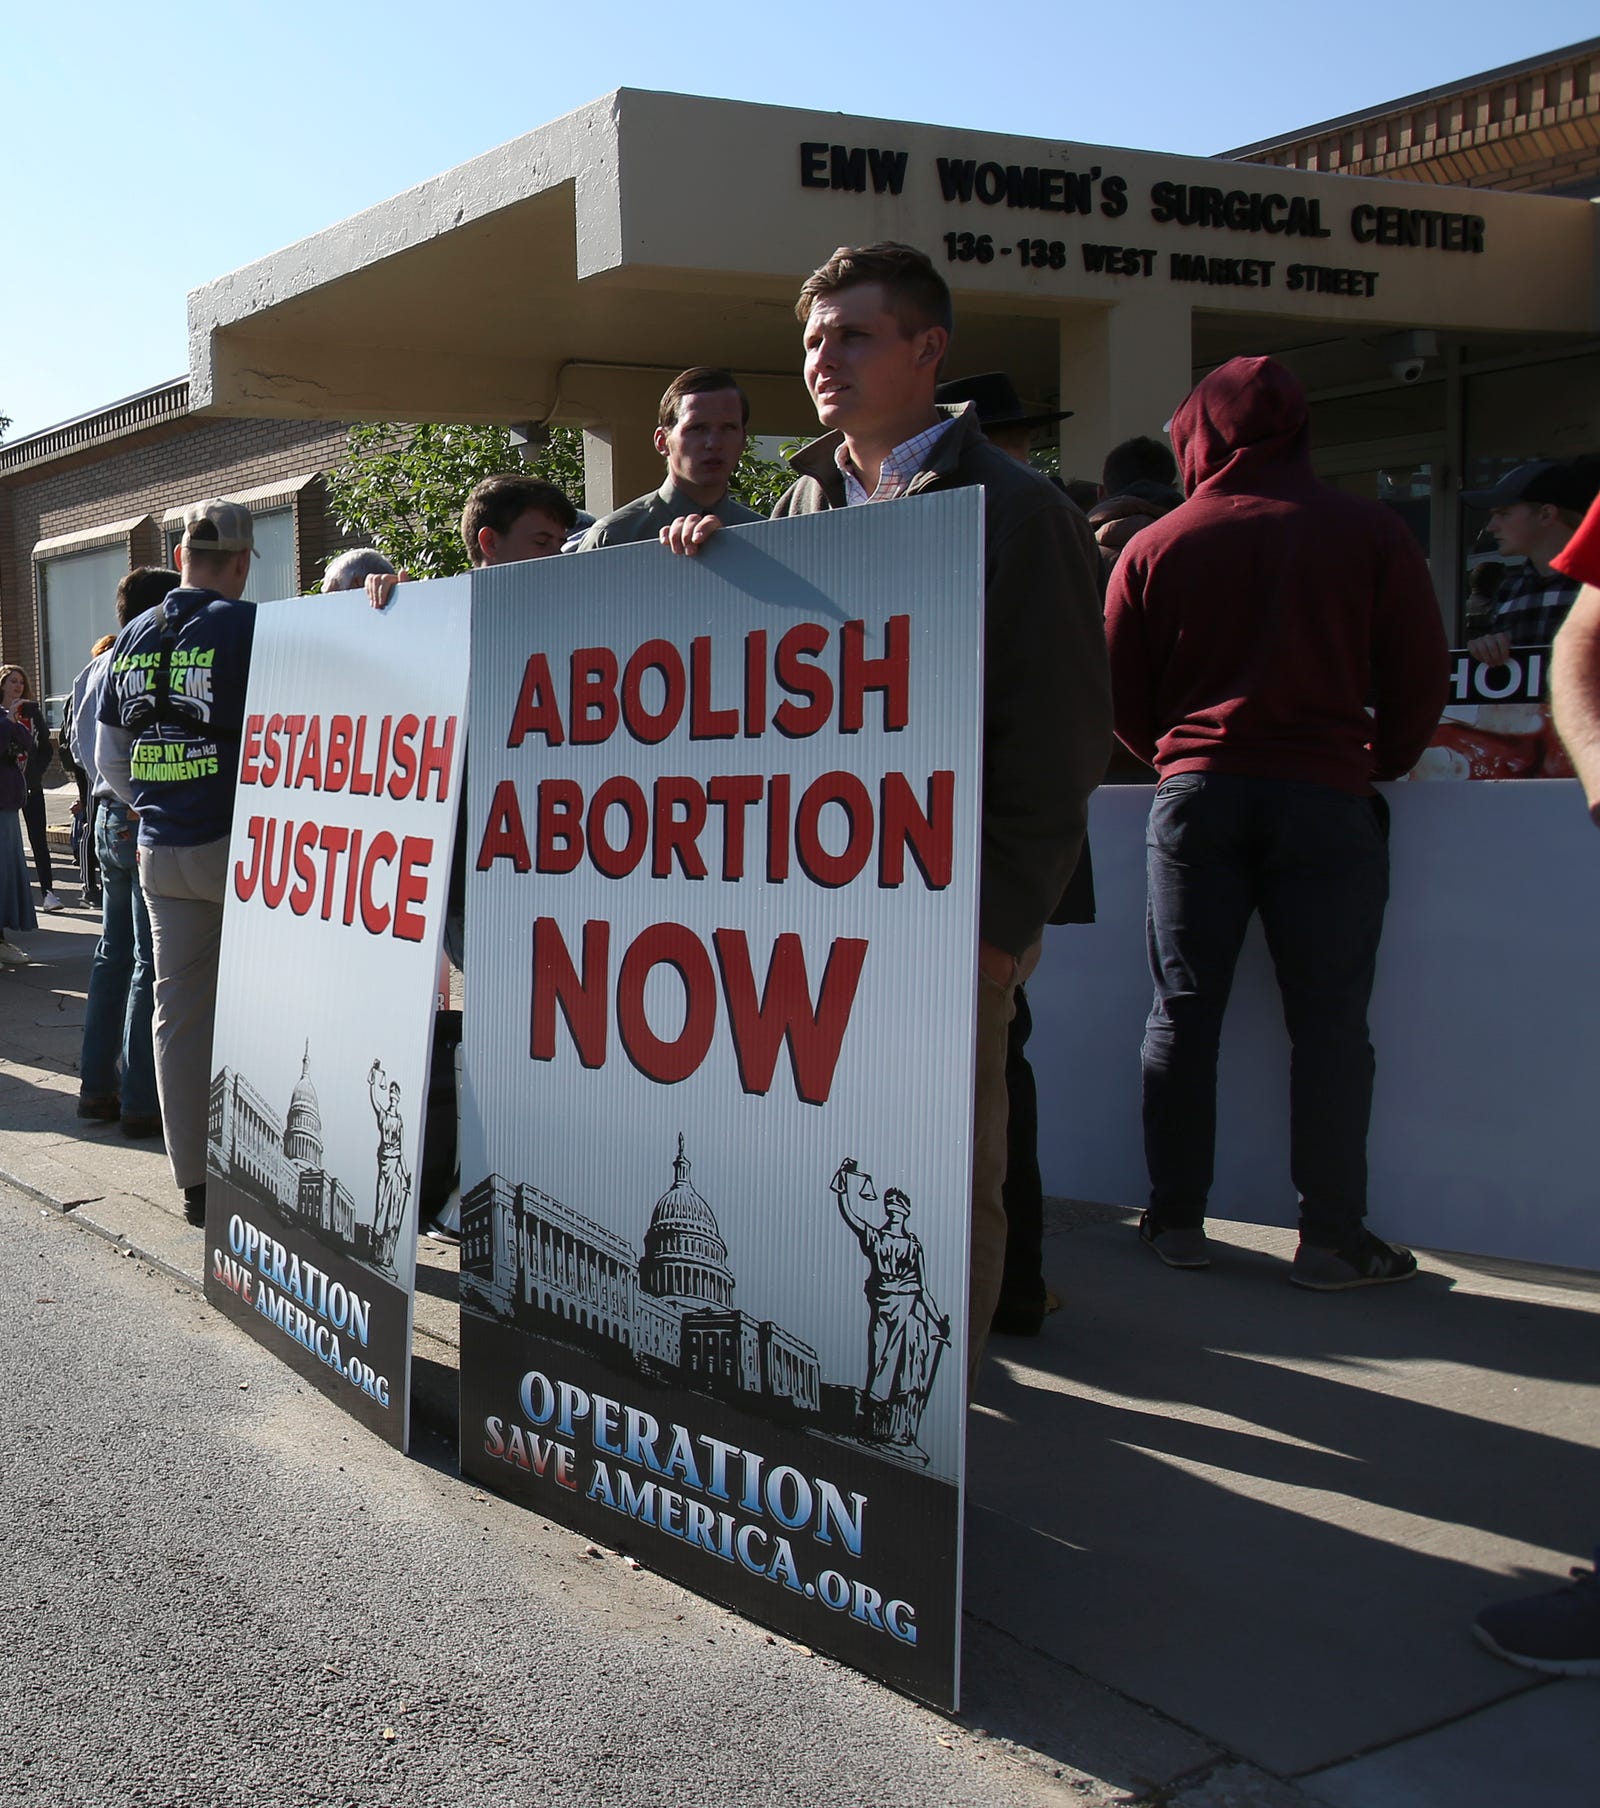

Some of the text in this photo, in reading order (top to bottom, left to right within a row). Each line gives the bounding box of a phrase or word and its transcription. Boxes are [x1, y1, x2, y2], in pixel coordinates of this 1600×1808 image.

[801, 142, 1485, 254] EMW WOMEN'S SURGICAL CENTER
[944, 232, 994, 264] 136
[1017, 238, 1066, 269] 138
[1082, 244, 1157, 276] WEST
[1170, 253, 1275, 287] MARKET
[1286, 263, 1379, 297] STREET
[112, 646, 215, 673] Jesus said
[146, 667, 184, 694] LVE
[185, 667, 214, 703] ME
[506, 614, 910, 748] ABOLISH
[132, 757, 219, 781] MANDMENTS
[133, 743, 185, 763] KEEP MY
[186, 747, 202, 758] John
[240, 713, 457, 803] ESTABLISH
[234, 816, 434, 943] JUSTICE
[475, 770, 955, 890] ABORTION
[530, 916, 869, 1107] NOW
[213, 1248, 390, 1409] SAVE AMERICA.ORG
[229, 1213, 372, 1348] OPERATION
[519, 1370, 868, 1558] OPERATION
[484, 1414, 918, 1646] SAVE AMERICA.ORG
